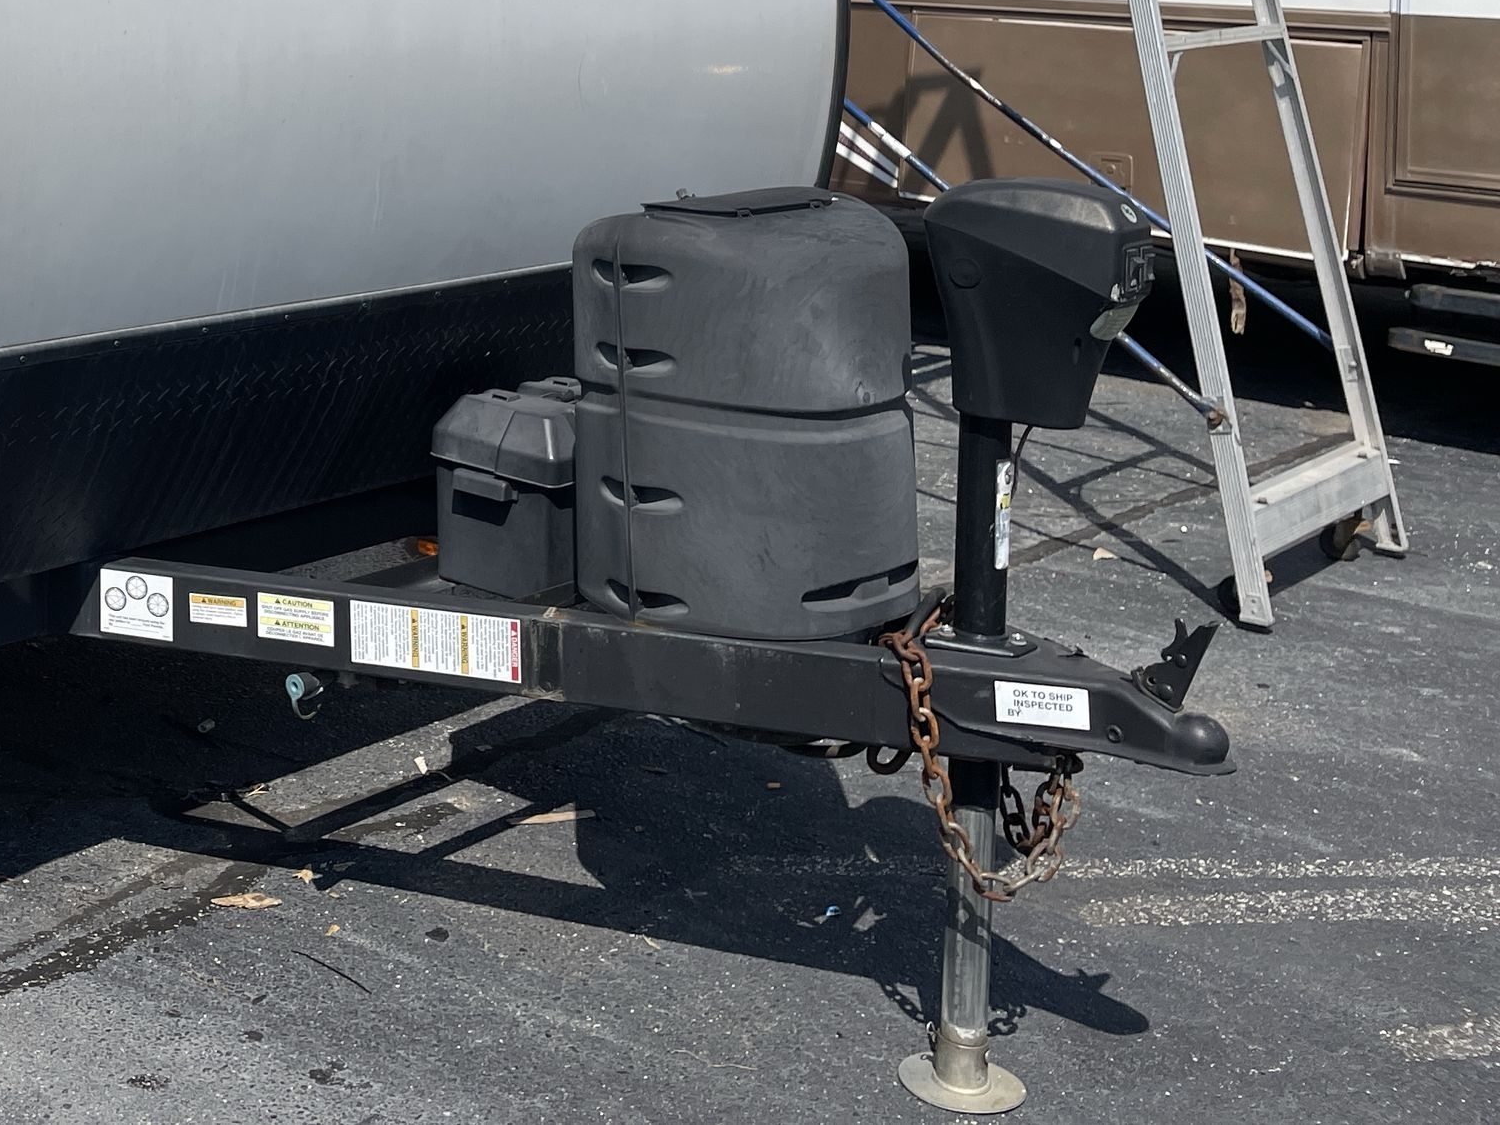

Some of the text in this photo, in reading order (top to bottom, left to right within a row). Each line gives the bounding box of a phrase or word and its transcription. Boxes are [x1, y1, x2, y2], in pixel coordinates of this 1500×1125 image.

[282, 599, 312, 608] CAUTION
[282, 621, 319, 631] ATTENTION
[1012, 689, 1073, 702] OK TO SHIP
[1014, 699, 1073, 712] INSPECTED
[1008, 708, 1022, 716] BY
